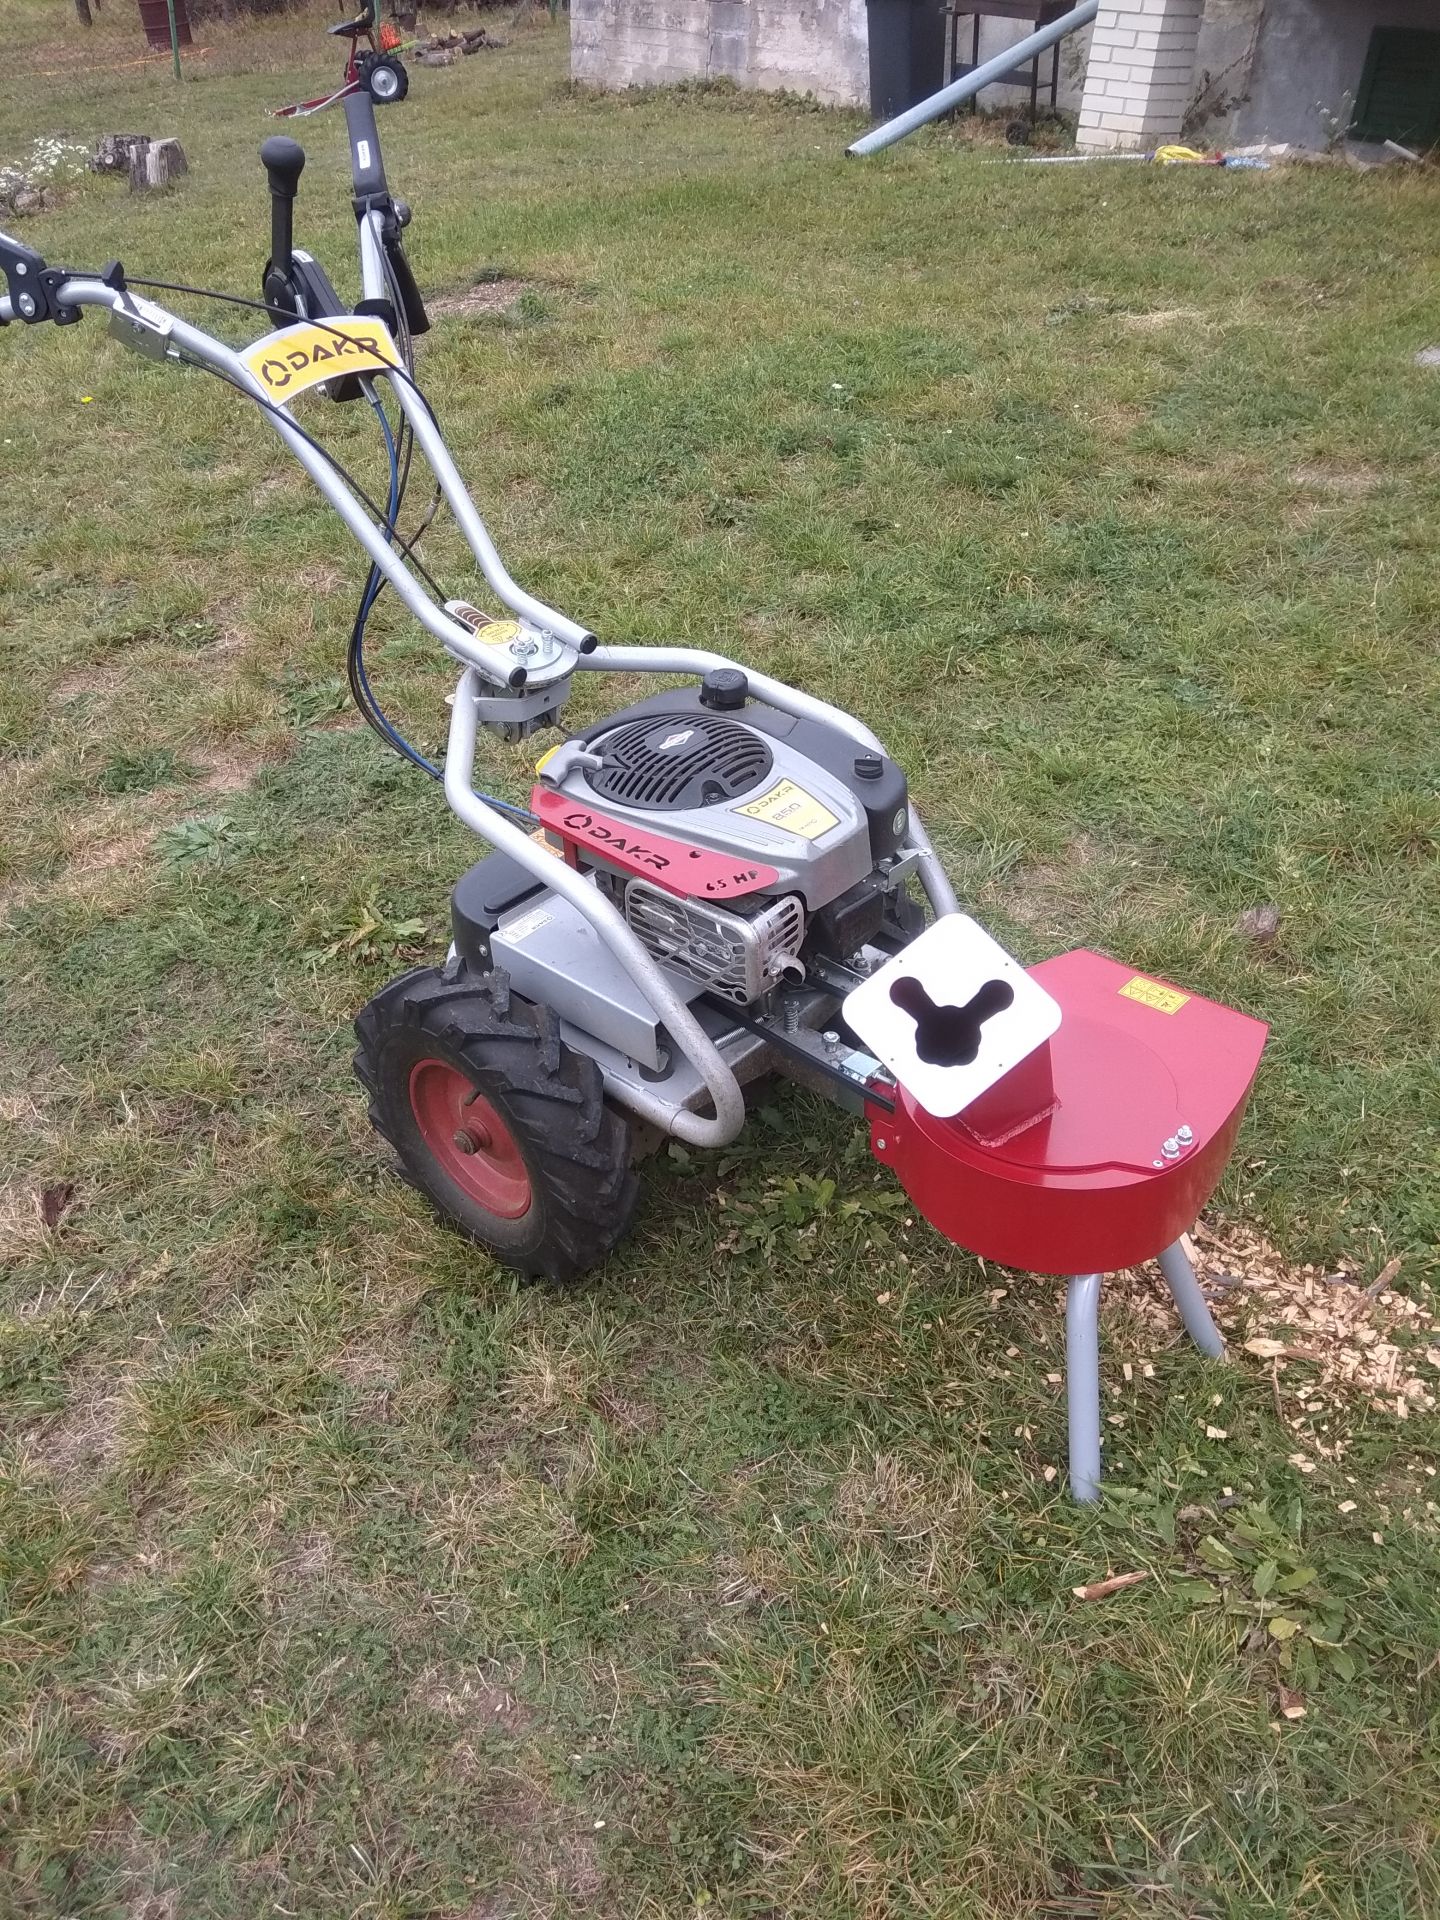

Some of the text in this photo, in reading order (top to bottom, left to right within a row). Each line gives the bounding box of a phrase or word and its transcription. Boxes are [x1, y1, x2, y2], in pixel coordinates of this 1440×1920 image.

[286, 337, 381, 371] DAKR
[588, 826, 671, 870] DAKR
[706, 870, 758, 891] 6.5 HP
